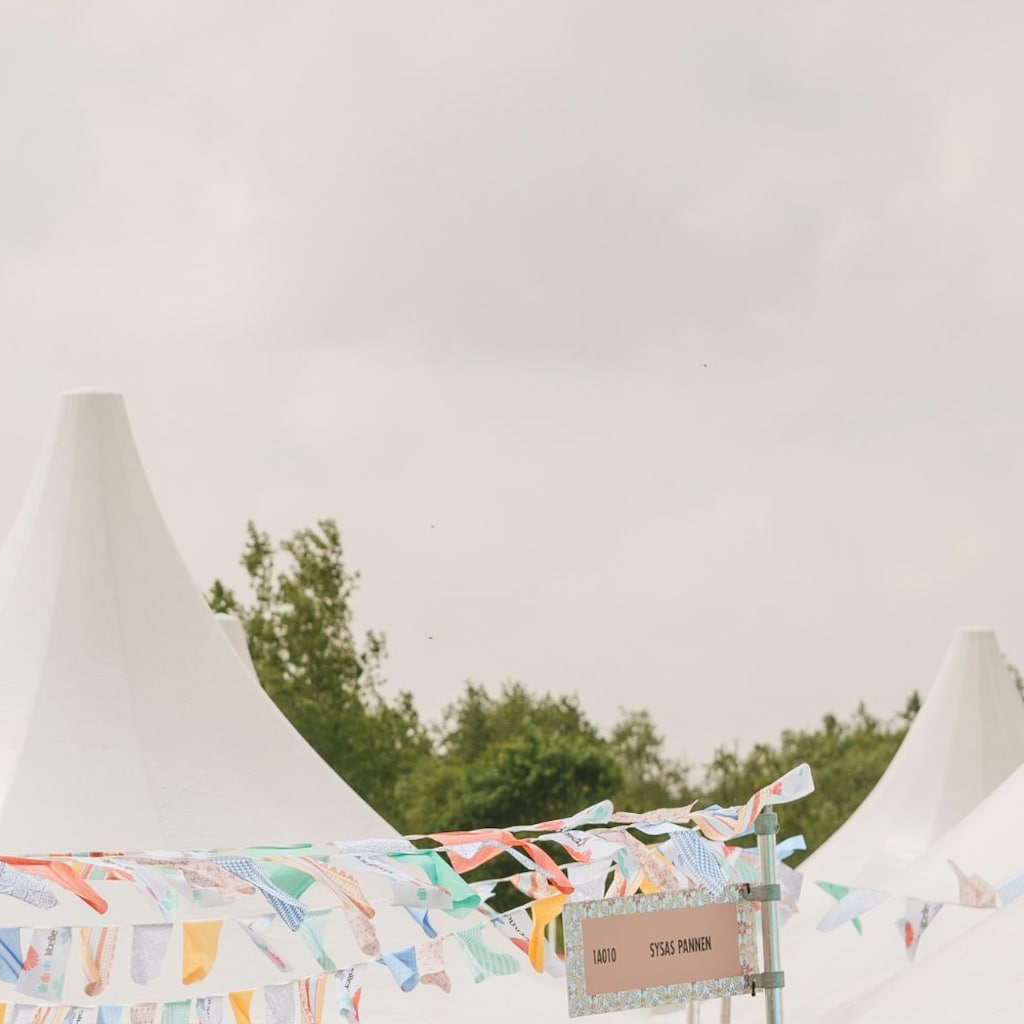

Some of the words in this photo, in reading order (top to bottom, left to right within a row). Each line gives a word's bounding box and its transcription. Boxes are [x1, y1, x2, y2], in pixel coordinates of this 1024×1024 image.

[592, 947, 617, 965] 1A010
[649, 940, 675, 958] SYSAS
[677, 936, 712, 954] PANNEN
